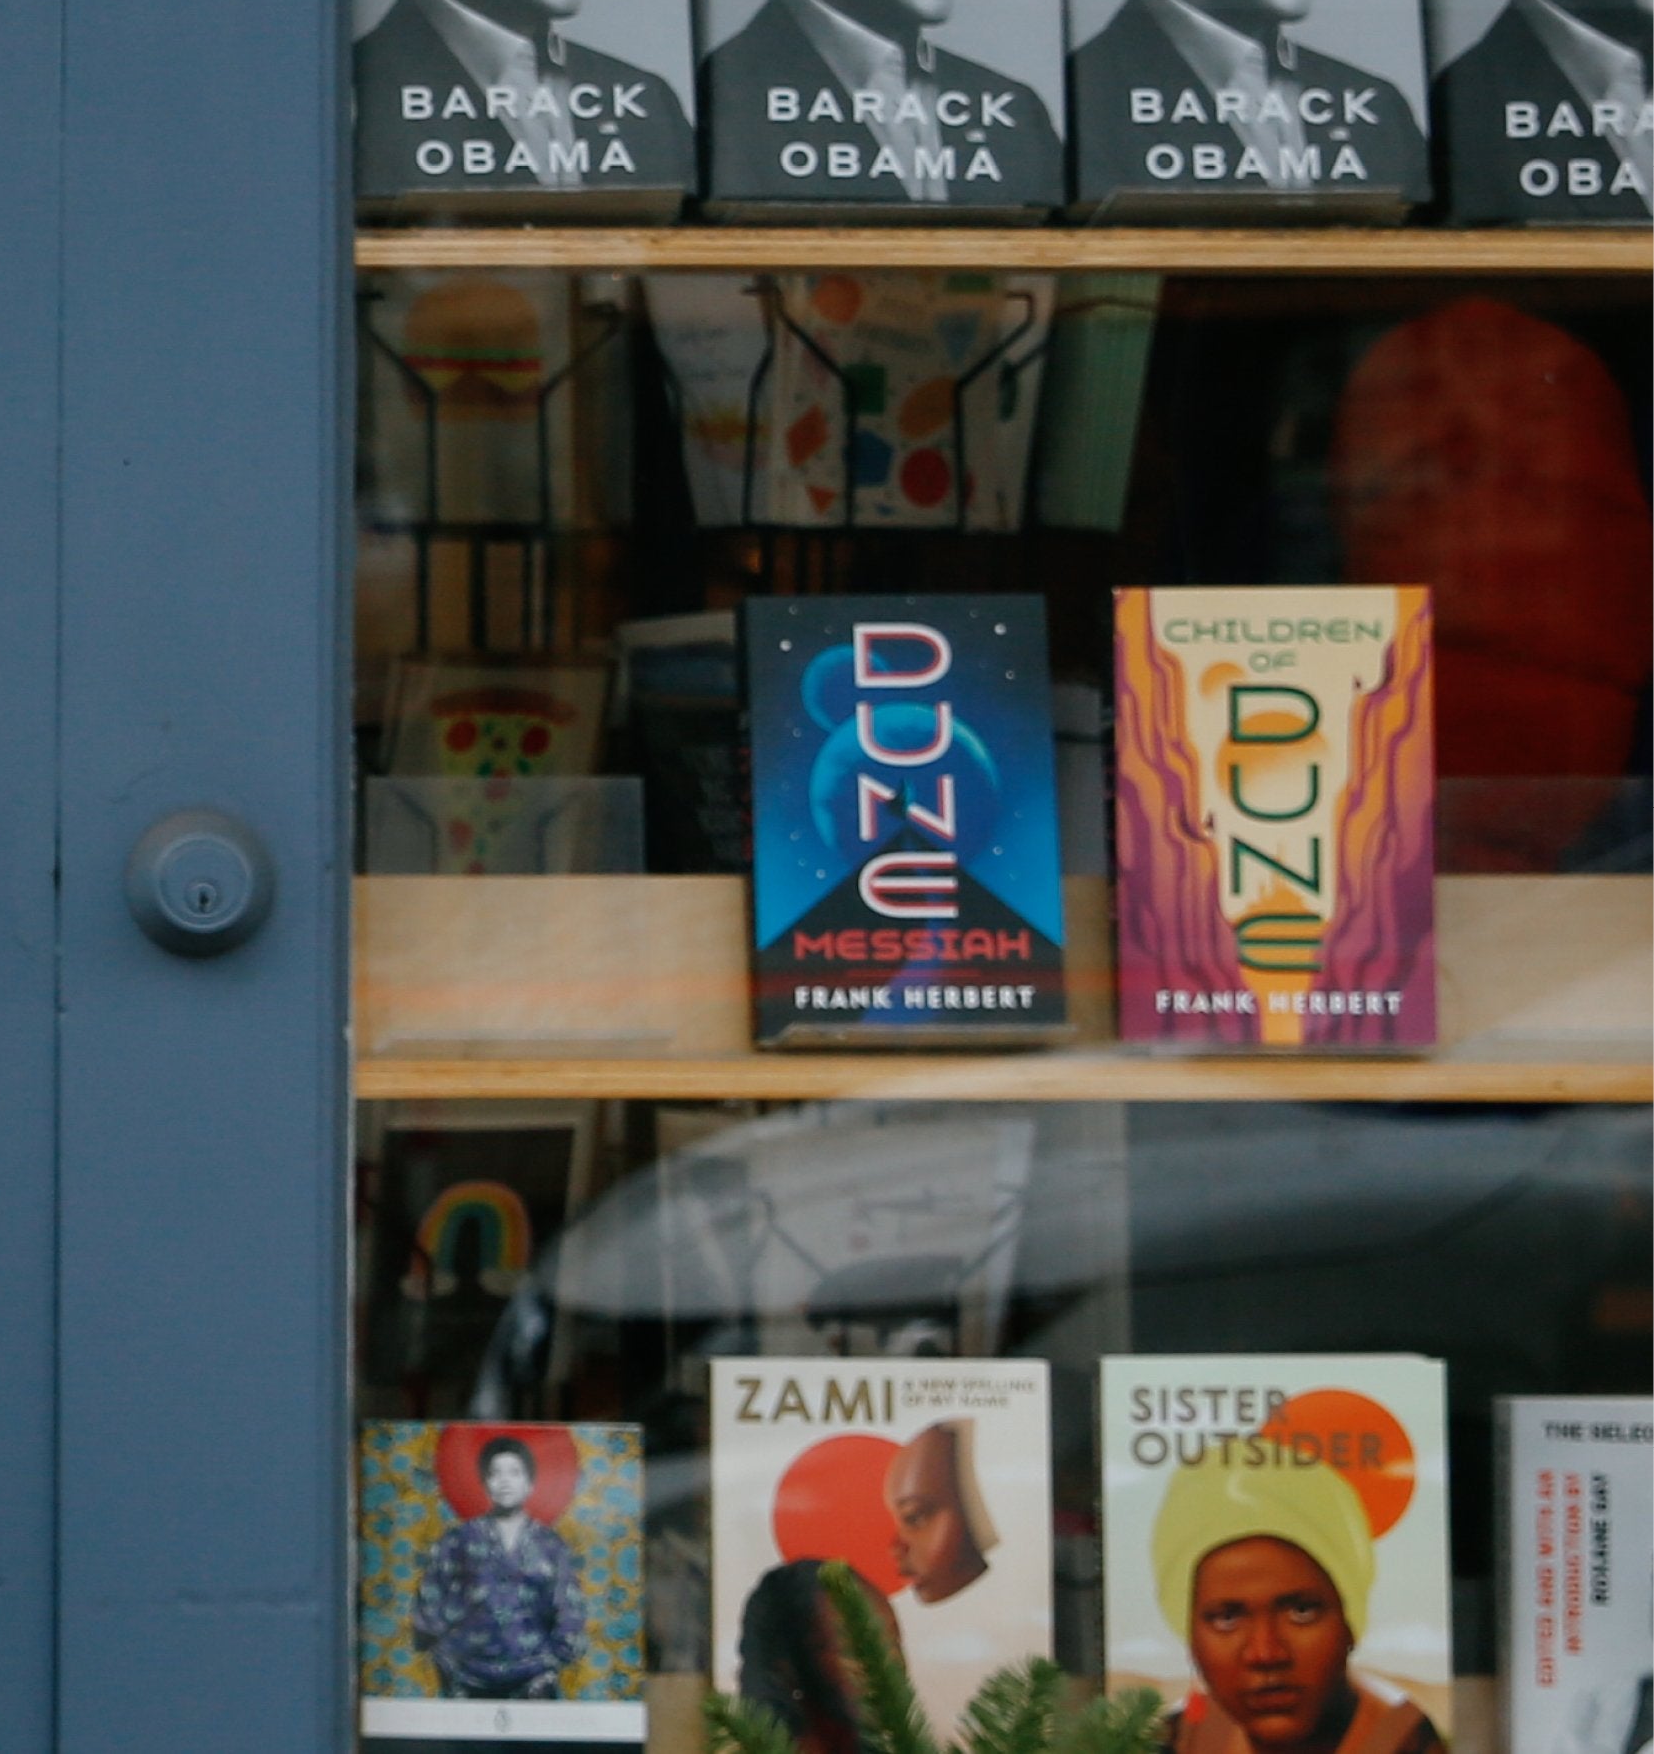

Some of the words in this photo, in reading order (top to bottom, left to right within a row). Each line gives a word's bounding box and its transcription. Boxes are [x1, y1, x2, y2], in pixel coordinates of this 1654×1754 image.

[401, 83, 648, 122] BARACK
[767, 86, 1017, 128] BARACK
[1129, 87, 1380, 126] BARACK
[415, 139, 637, 176] OBAMA
[780, 141, 1003, 183] OBAMA
[1145, 144, 1368, 181] OBAMA
[1162, 617, 1384, 644] CHILDREN
[1248, 649, 1298, 674] OF
[852, 621, 960, 920] DUNE
[1228, 685, 1323, 974] DUNE
[794, 930, 1032, 962] MESSIAH
[794, 985, 893, 1010] FRANK
[904, 985, 1037, 1010] HERBERT
[1154, 989, 1258, 1015] FRANK
[1268, 989, 1404, 1017] HERBERT
[734, 1376, 895, 1424] ZAMI
[1130, 1387, 1289, 1423] SISTER
[1131, 1431, 1384, 1468] OUTSIDER
